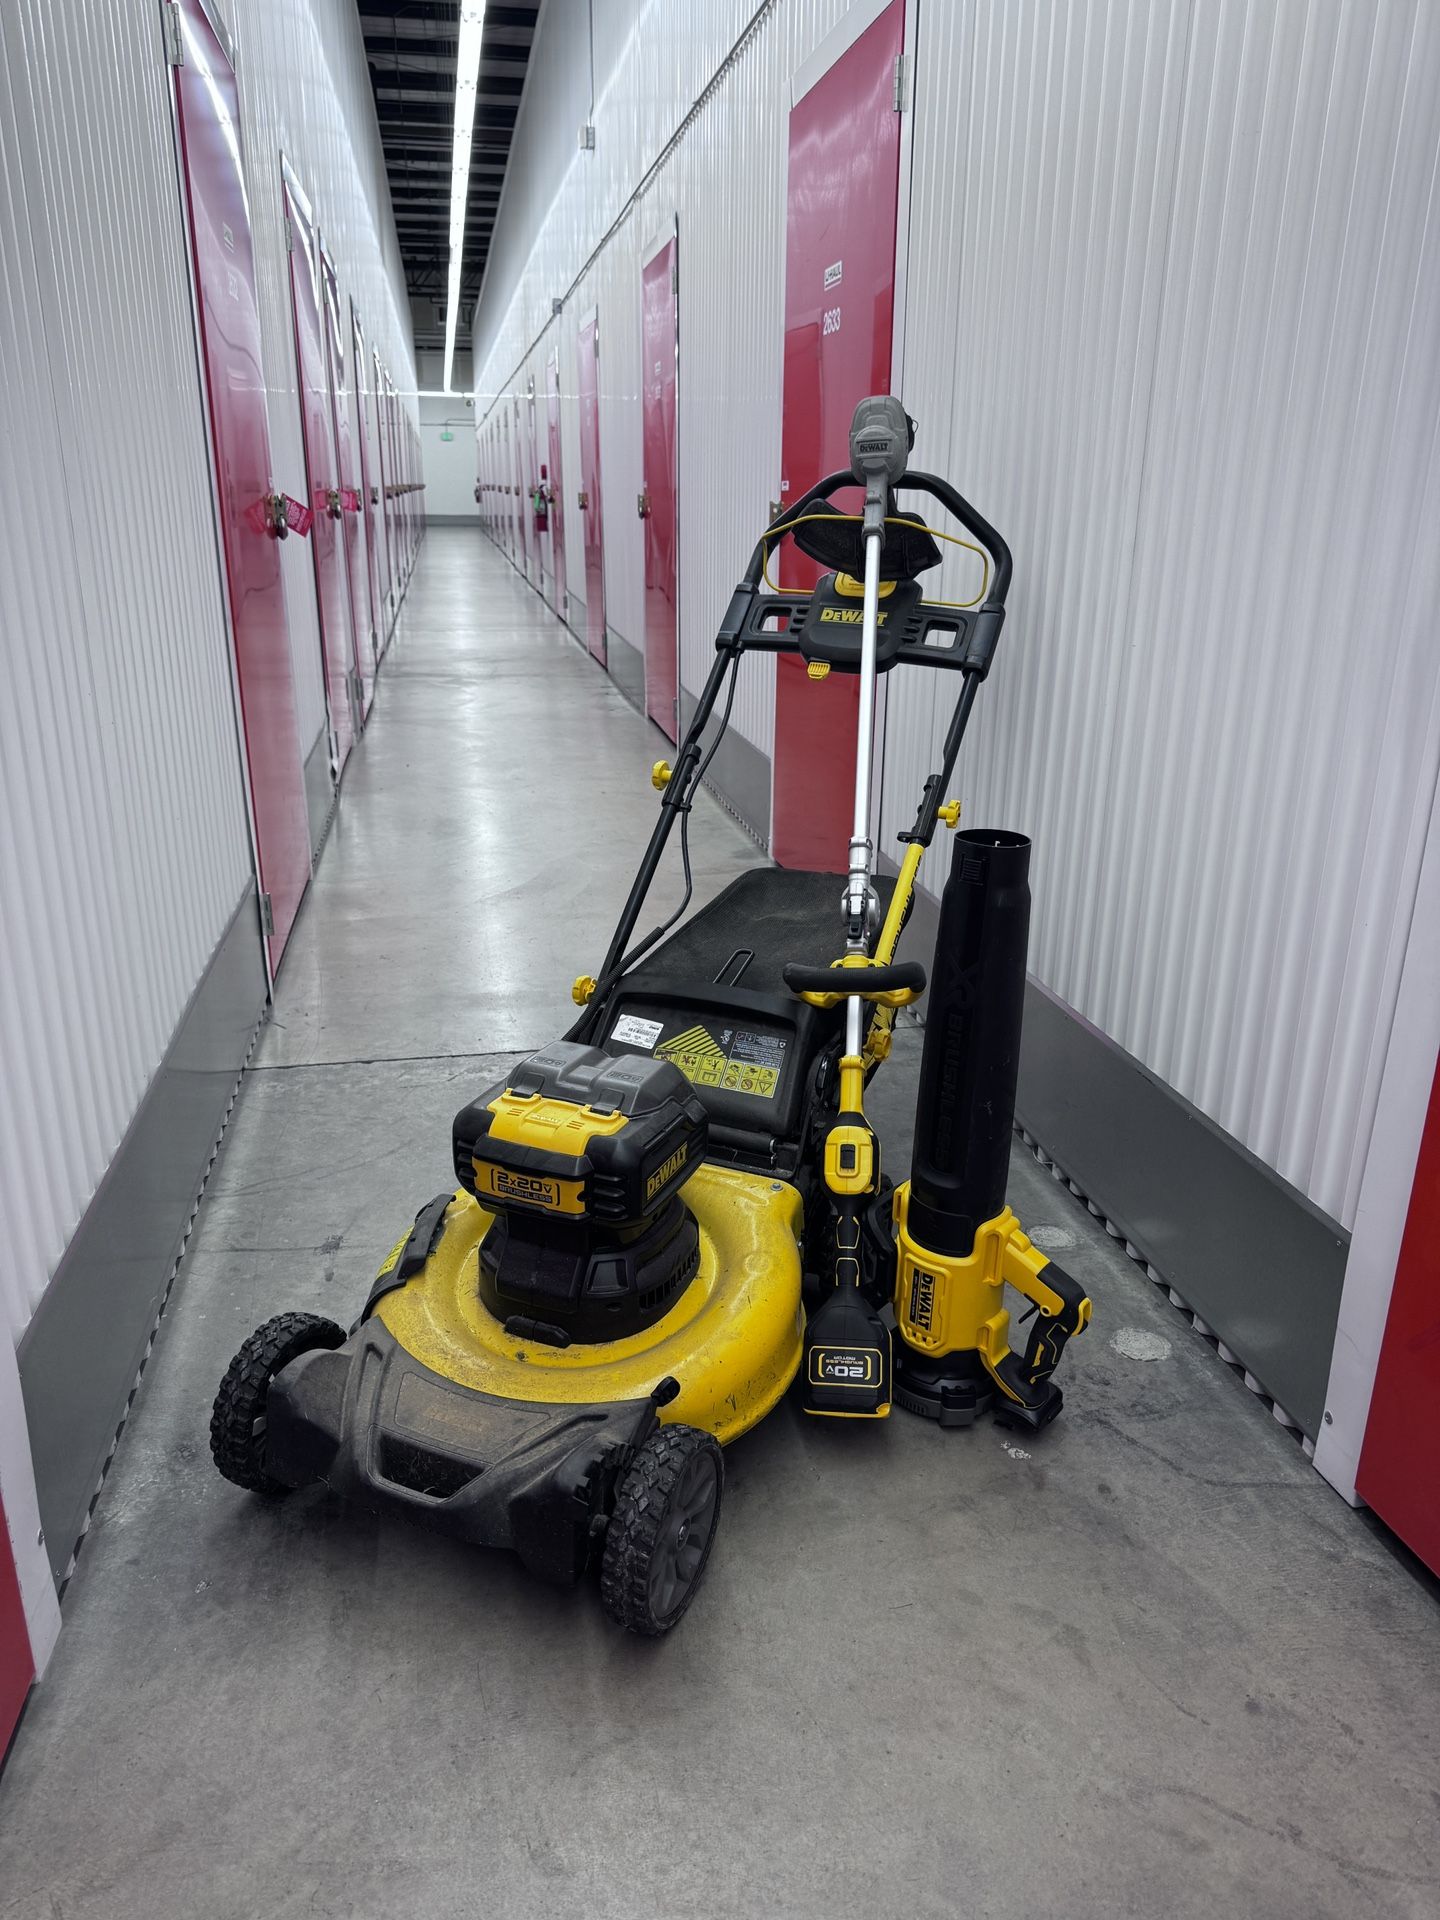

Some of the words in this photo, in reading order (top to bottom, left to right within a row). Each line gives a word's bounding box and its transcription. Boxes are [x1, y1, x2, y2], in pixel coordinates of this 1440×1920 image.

[823, 307, 841, 335] 2633
[820, 608, 888, 626] DEWAT
[647, 1143, 688, 1197] DEWALT
[918, 1272, 935, 1331] DEWALT
